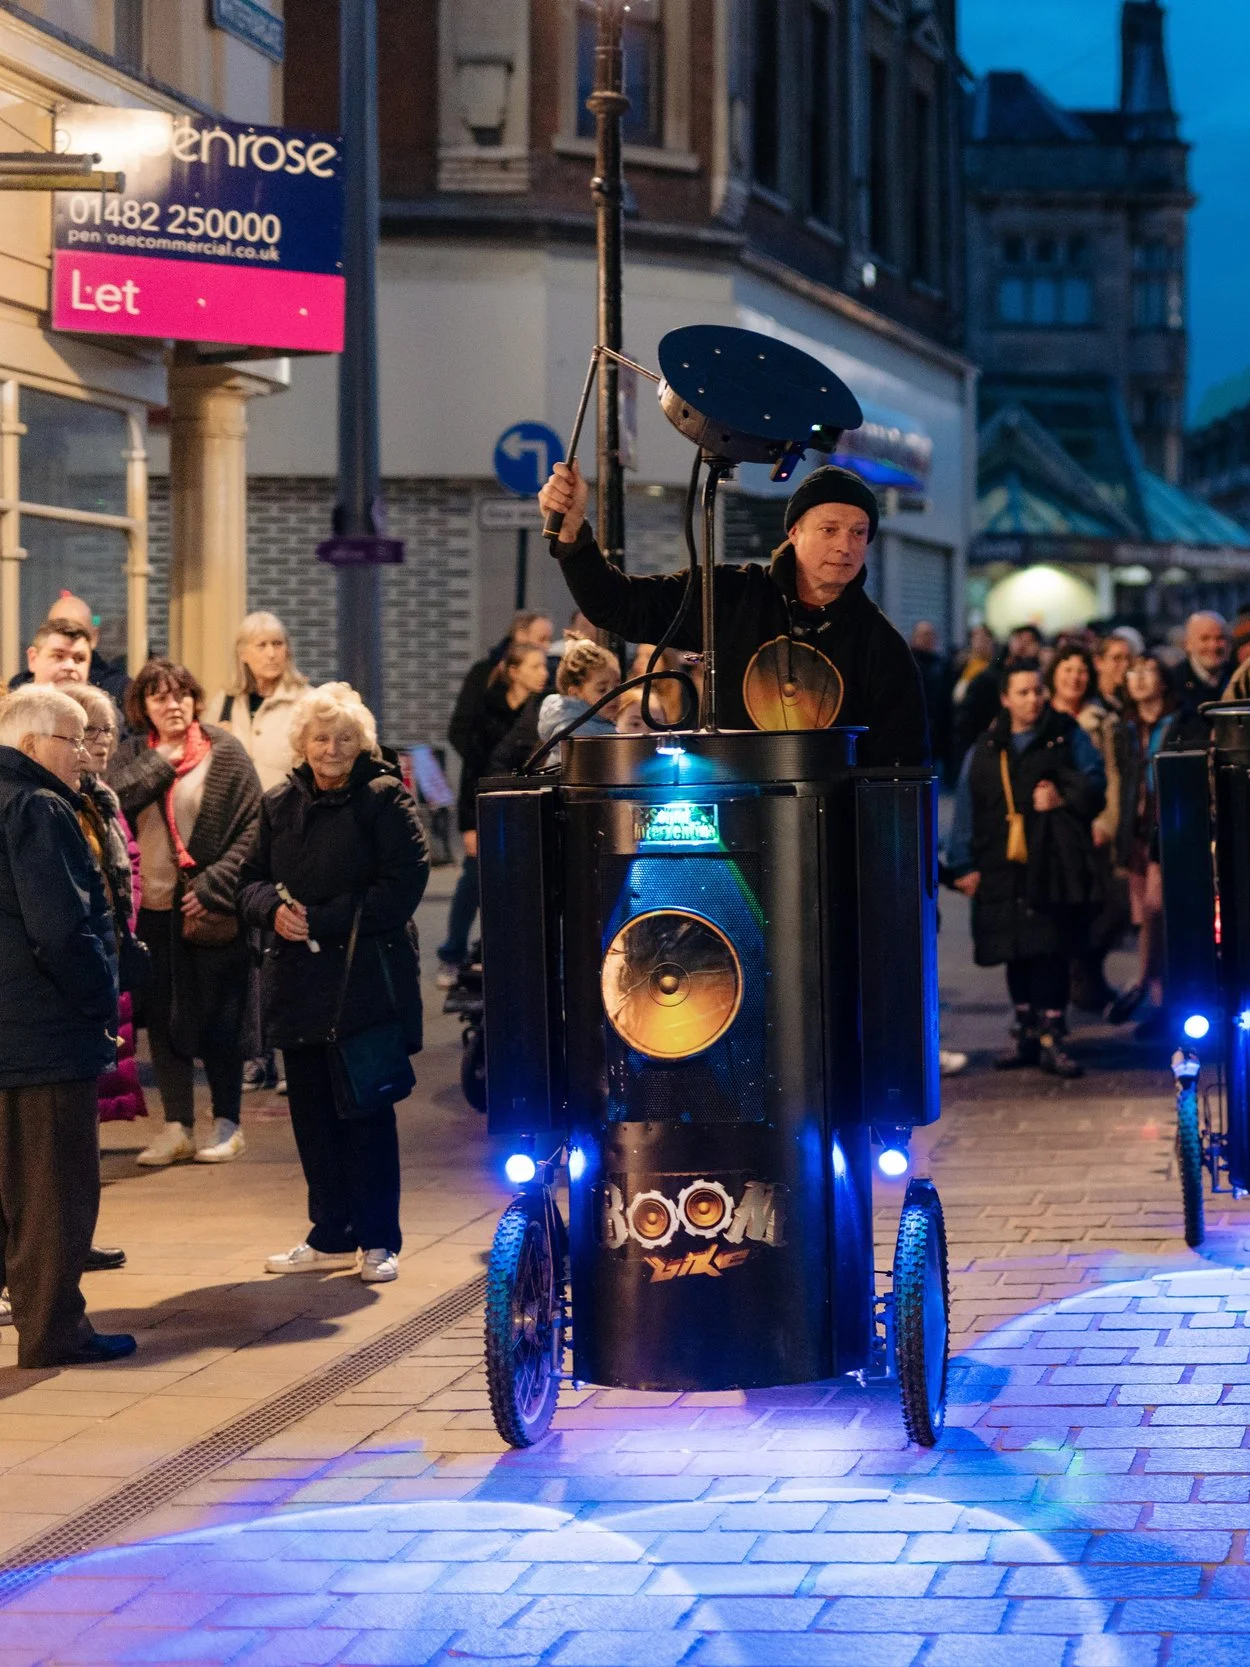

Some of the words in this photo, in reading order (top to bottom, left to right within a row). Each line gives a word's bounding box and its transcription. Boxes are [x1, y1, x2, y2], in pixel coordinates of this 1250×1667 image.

[172, 124, 337, 178] enrose
[69, 195, 160, 231] 01482
[167, 204, 281, 244] 250000
[68, 230, 280, 261] penosecommercial.co.uk
[71, 268, 141, 315] Let
